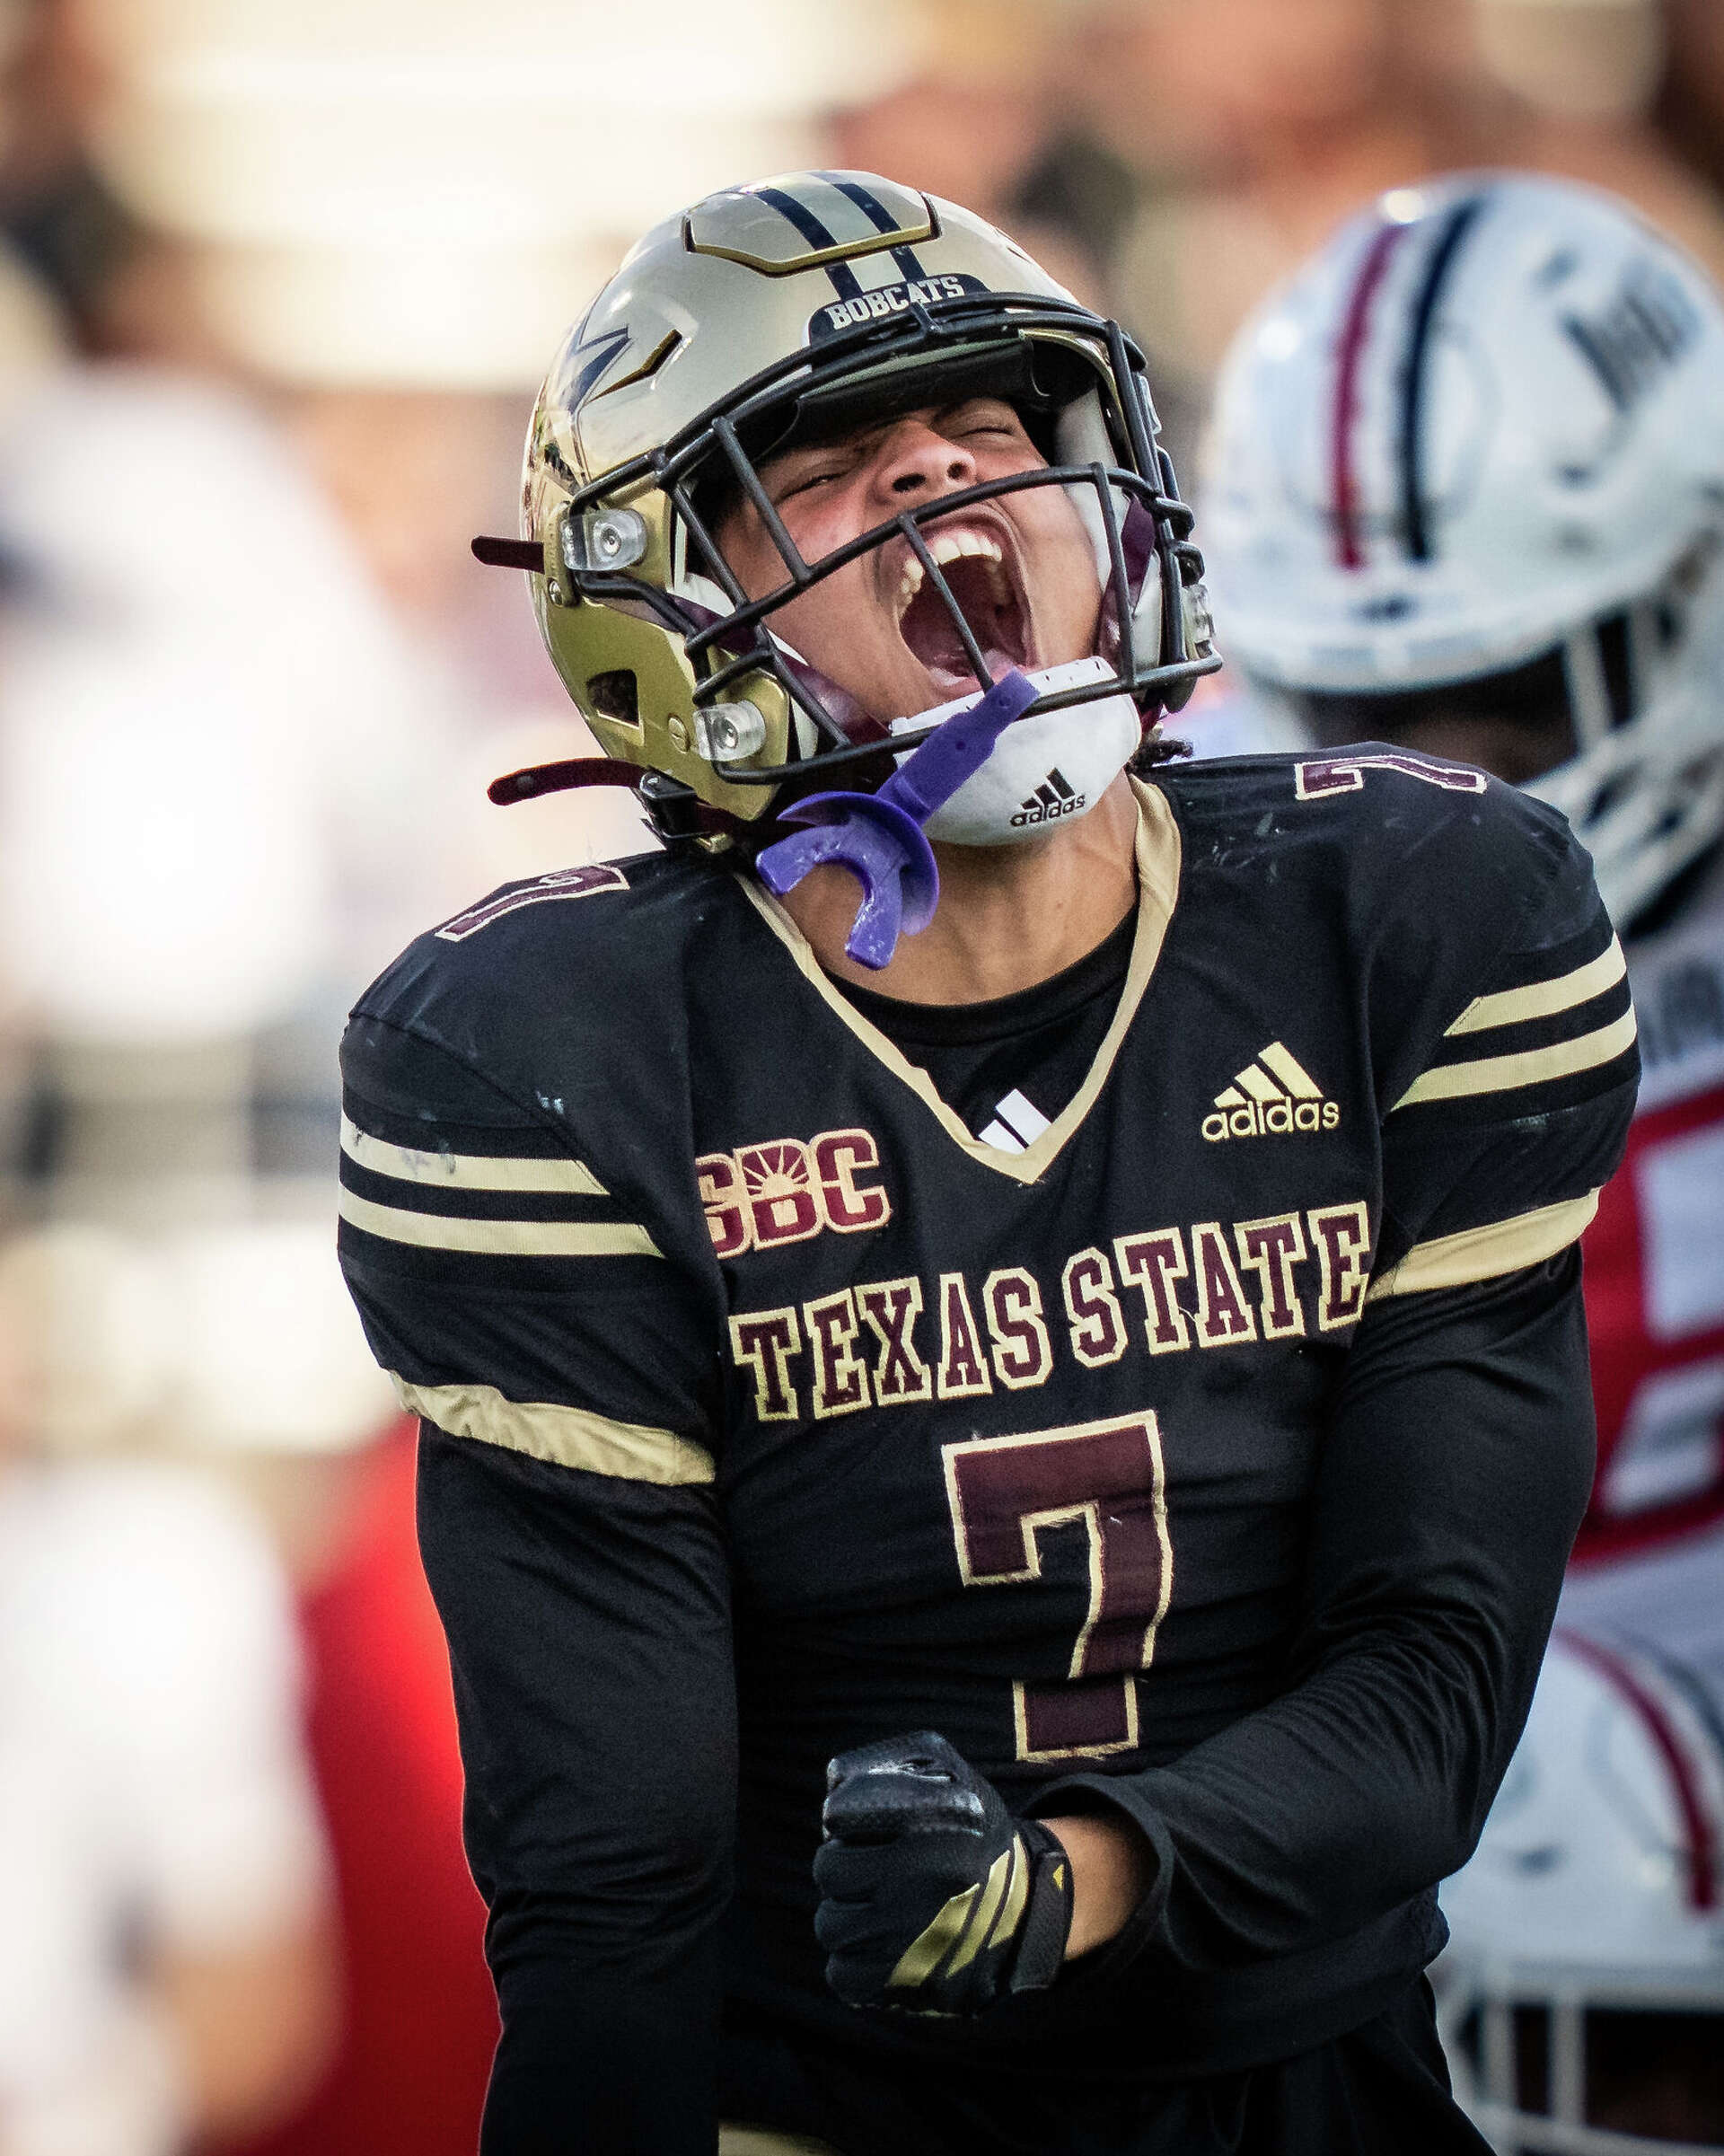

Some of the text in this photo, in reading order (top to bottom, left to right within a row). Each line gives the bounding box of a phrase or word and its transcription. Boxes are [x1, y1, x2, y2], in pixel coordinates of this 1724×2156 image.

[824, 276, 964, 330] BOBCATS
[1294, 754, 1487, 800] 7
[1009, 795, 1086, 827] adidas
[1201, 1096, 1340, 1142] adidas
[729, 1201, 1370, 1421] TEXAS STATE
[941, 1410, 1174, 1761] 7
